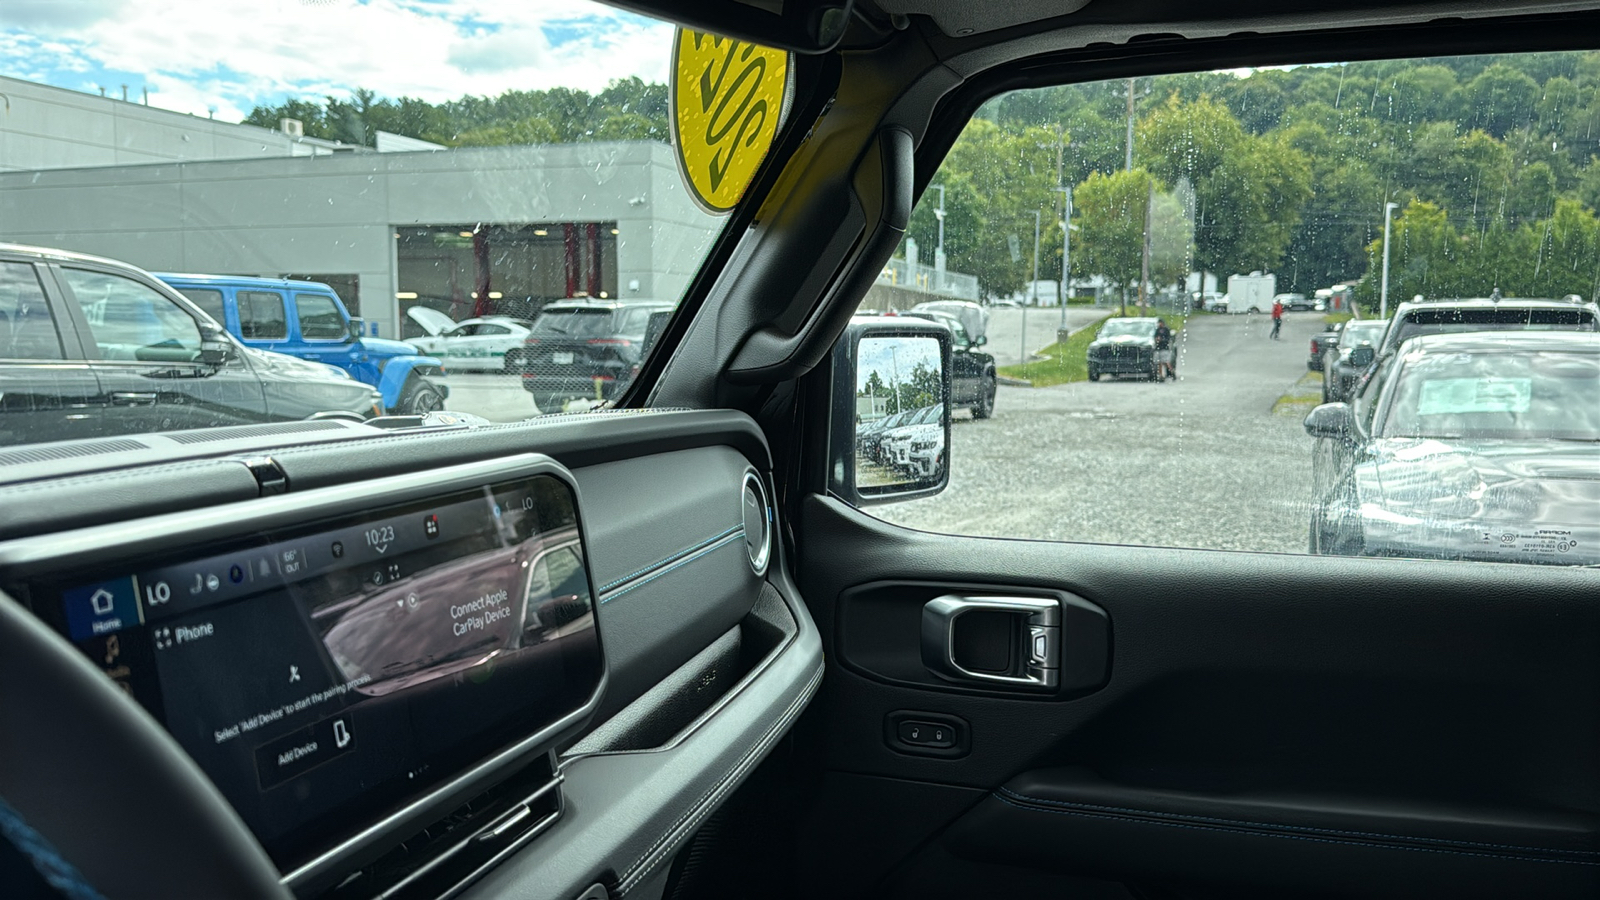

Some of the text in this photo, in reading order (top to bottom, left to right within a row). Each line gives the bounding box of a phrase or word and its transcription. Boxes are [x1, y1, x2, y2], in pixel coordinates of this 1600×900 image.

[521, 497, 533, 510] LO
[365, 526, 395, 546] 10:23
[285, 562, 300, 573] OUT
[146, 581, 171, 606] LO
[450, 589, 508, 620] Connect Apple
[92, 618, 122, 634] Home
[175, 622, 214, 643] Phone
[453, 605, 511, 637] CarPlay Device
[214, 724, 240, 744] Select
[286, 704, 295, 715] to
[295, 696, 311, 712] start
[311, 692, 323, 705] the
[323, 683, 347, 701] pairing
[346, 673, 372, 692] process
[278, 741, 318, 766] Add Device
